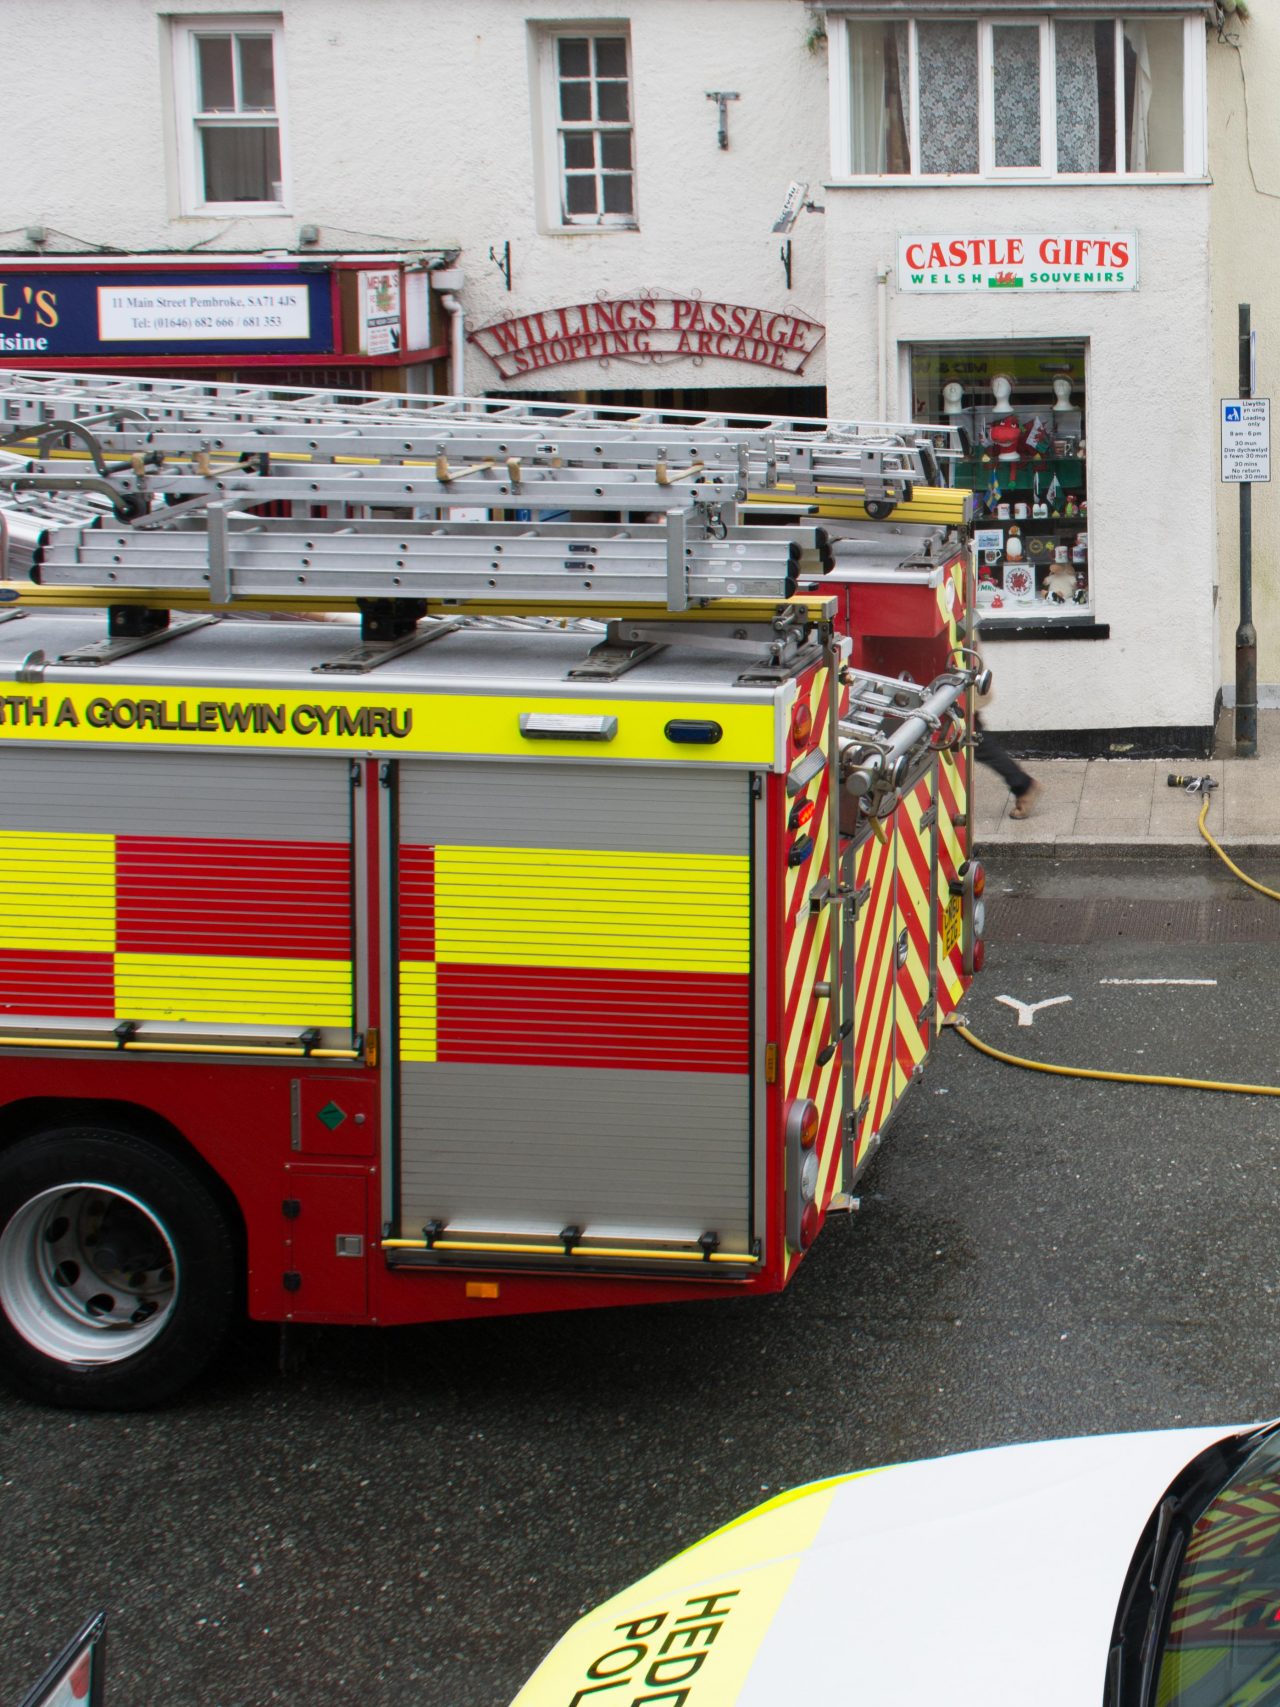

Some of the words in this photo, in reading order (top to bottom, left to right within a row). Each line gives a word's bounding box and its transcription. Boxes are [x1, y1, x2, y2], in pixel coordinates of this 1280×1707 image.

[906, 239, 1025, 269] CASTLE
[1039, 238, 1130, 268] GIFTS
[911, 274, 982, 284] WELSH
[1030, 272, 1124, 283] SOUVENIRS
[112, 298, 122, 308] 11
[127, 298, 153, 308] Main
[157, 298, 186, 308] Street
[190, 297, 245, 309] Pembroke,
[248, 297, 274, 307] SA71
[278, 296, 297, 306] 4JS
[131, 318, 150, 328] Tel:
[154, 318, 192, 329] (01646)
[194, 317, 212, 327] 682
[216, 317, 234, 327] 666
[243, 317, 260, 326] 681
[264, 316, 282, 326] 353
[491, 302, 656, 353] WILLINGS
[672, 301, 811, 349] PASSAGE
[0, 333, 48, 351] isine
[517, 331, 649, 371] SHOPPING
[678, 330, 787, 368] ARCADE
[55, 697, 81, 727] A
[86, 698, 287, 734] GORLLEWIN
[291, 704, 413, 737] CYMRU
